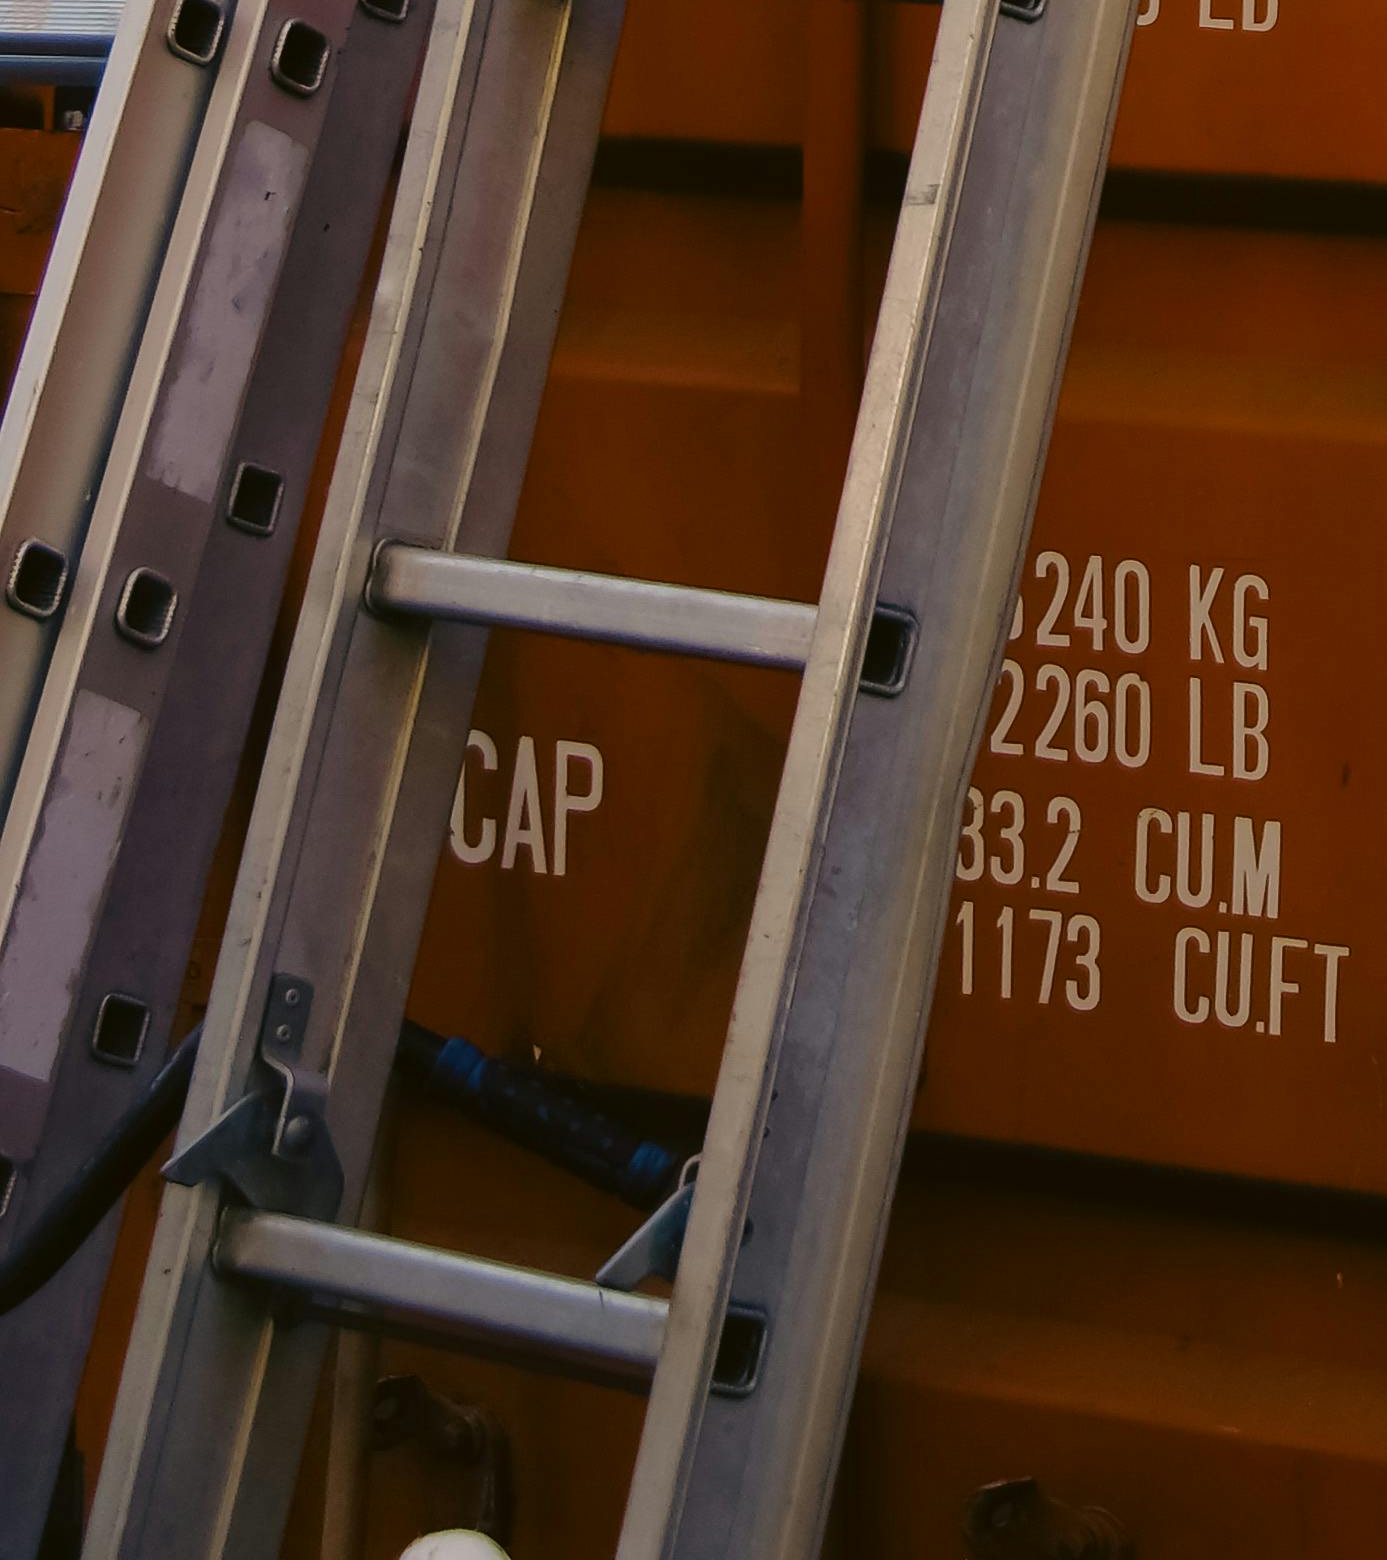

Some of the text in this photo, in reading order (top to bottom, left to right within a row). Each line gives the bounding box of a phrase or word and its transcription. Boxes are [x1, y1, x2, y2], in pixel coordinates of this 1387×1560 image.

[1007, 550, 1270, 670] 240 KG
[1187, 676, 1270, 782] LB
[448, 730, 605, 877] CAP
[955, 784, 1281, 920] 33.2 CU.M
[1171, 926, 1351, 1044] CU.FT
